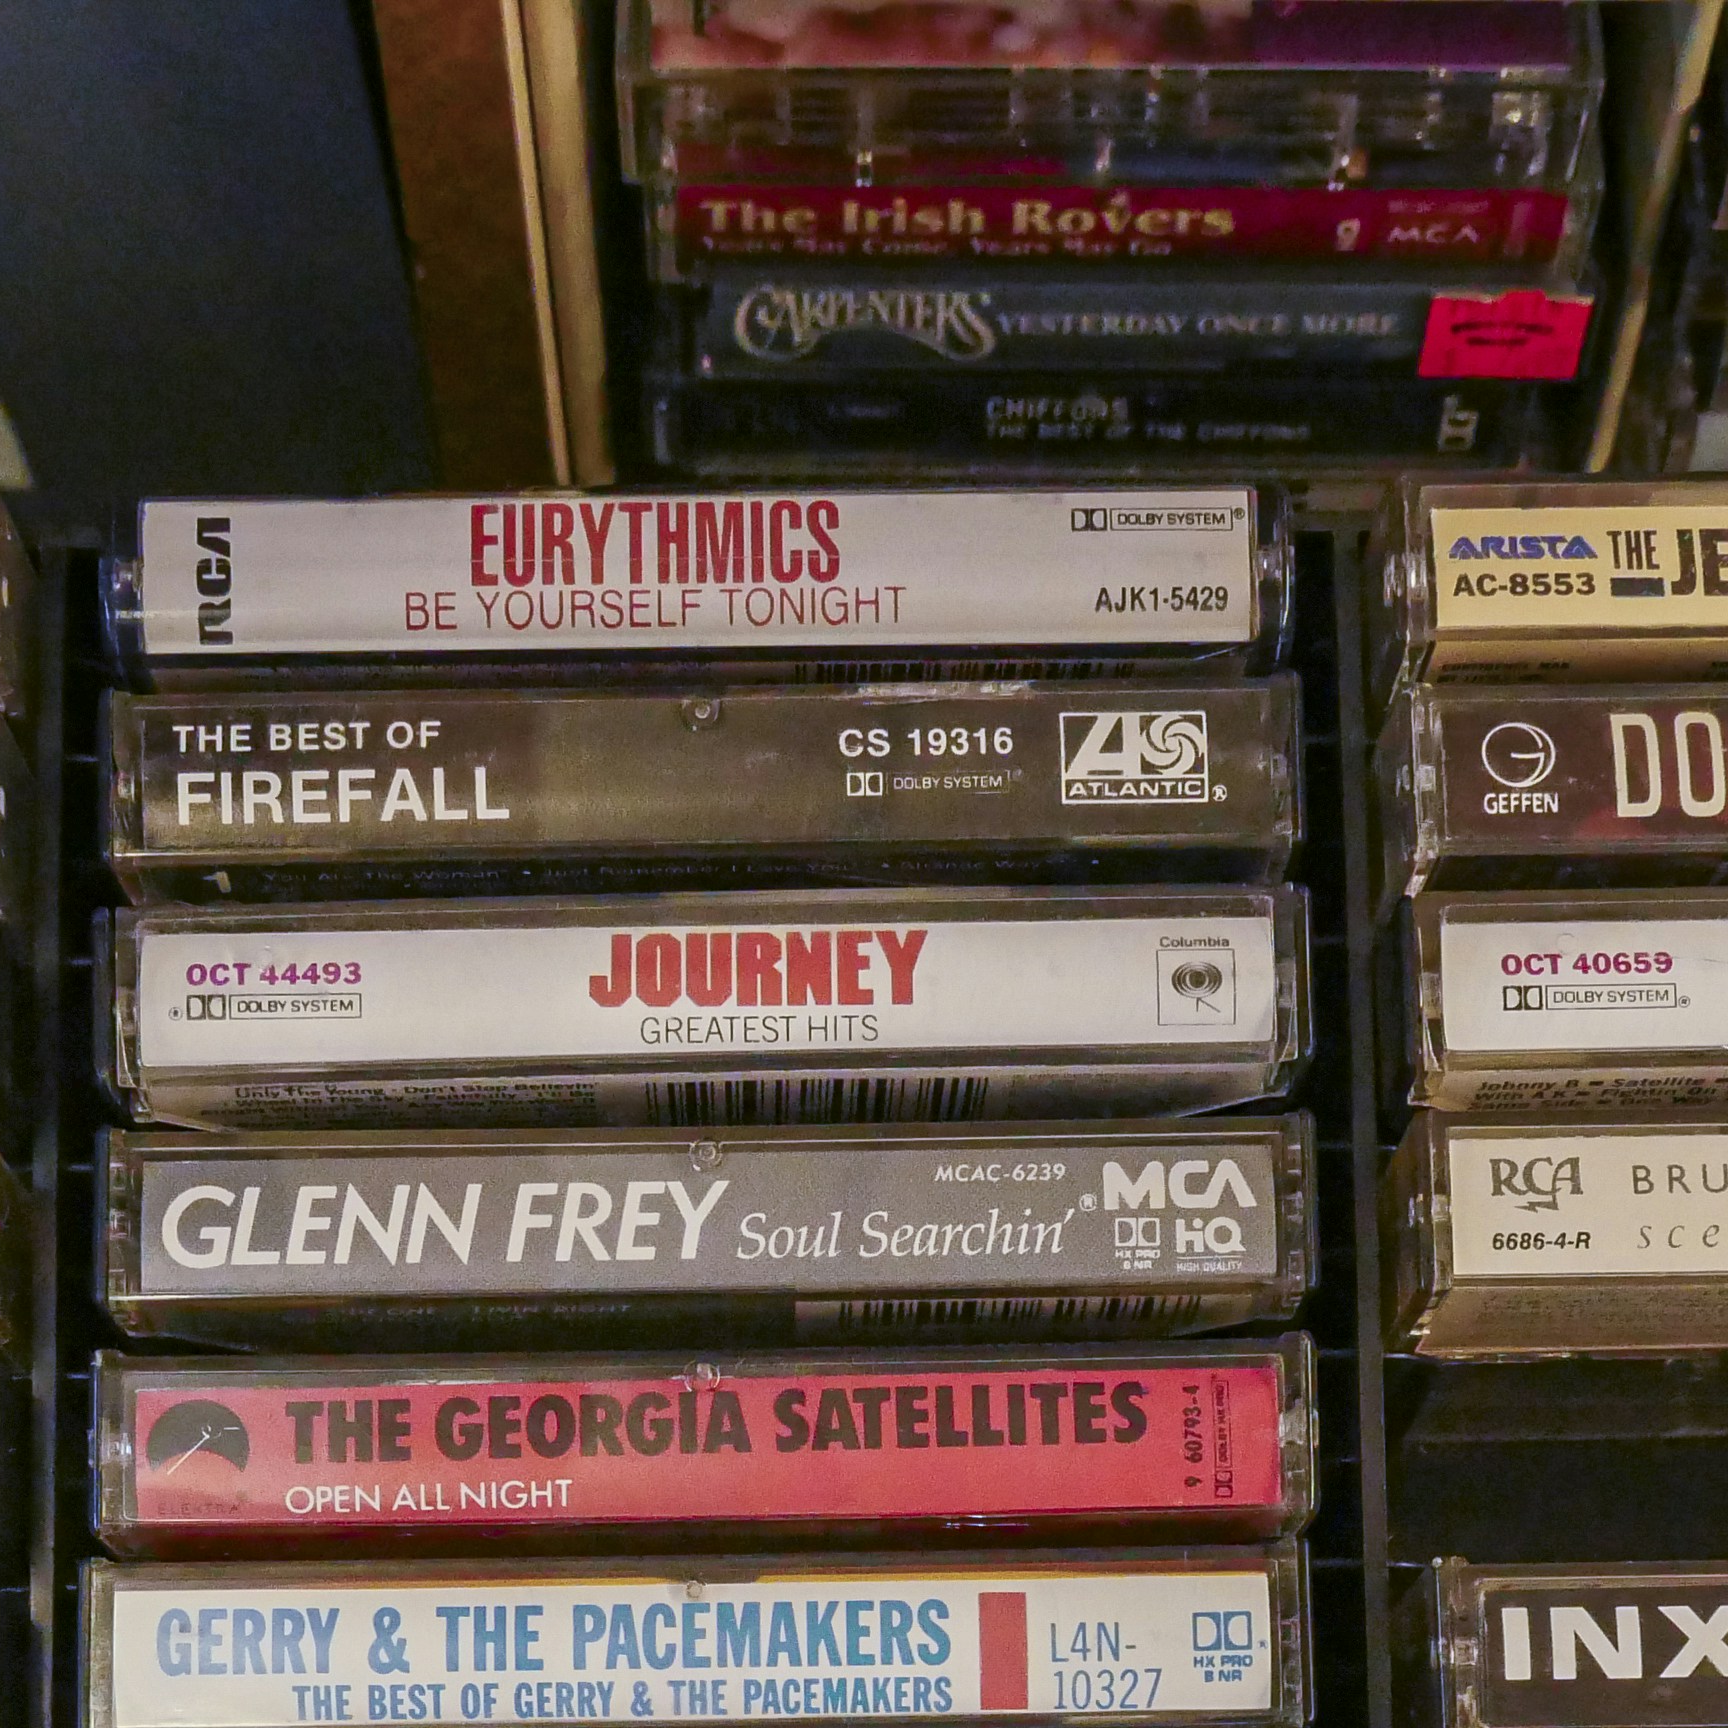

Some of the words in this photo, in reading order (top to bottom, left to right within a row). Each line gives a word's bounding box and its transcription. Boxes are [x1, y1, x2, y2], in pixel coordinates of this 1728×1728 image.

[700, 201, 816, 235] The
[842, 198, 986, 235] Irish
[1011, 191, 1236, 236] Rovers
[471, 500, 841, 588] EURYTHMICS
[1606, 529, 1660, 571] THE
[1095, 587, 1230, 614] AJK1-5429
[1452, 573, 1598, 597] AC-8553
[404, 591, 458, 631] BE
[477, 588, 701, 630] YOURSELF
[727, 586, 907, 627] TONIGHT
[172, 724, 252, 753] THE
[268, 722, 370, 752] BEST
[385, 720, 442, 750] OF
[176, 767, 511, 826] FIREFALL
[1066, 780, 1204, 799] ATLANTIC
[1483, 792, 1560, 816] GEFFEN
[588, 930, 930, 1009] JOURNEY
[639, 1014, 797, 1045] GREATEST
[807, 1012, 879, 1042] HITS
[934, 1162, 1068, 1182] MCAC-6239
[161, 1182, 483, 1269] GLENN
[504, 1178, 731, 1264] FREY
[735, 1210, 843, 1261] Soul
[858, 1206, 1077, 1258] Searchin'
[1491, 1231, 1592, 1252] 6686-4-R
[285, 1398, 413, 1465] THE
[433, 1389, 753, 1461] GEORGIA
[772, 1380, 1148, 1454] SATELLITES
[155, 1607, 342, 1678] GERRY
[366, 1606, 411, 1675] &
[435, 1604, 545, 1674] THE
[571, 1599, 952, 1671] PACEMAKERS
